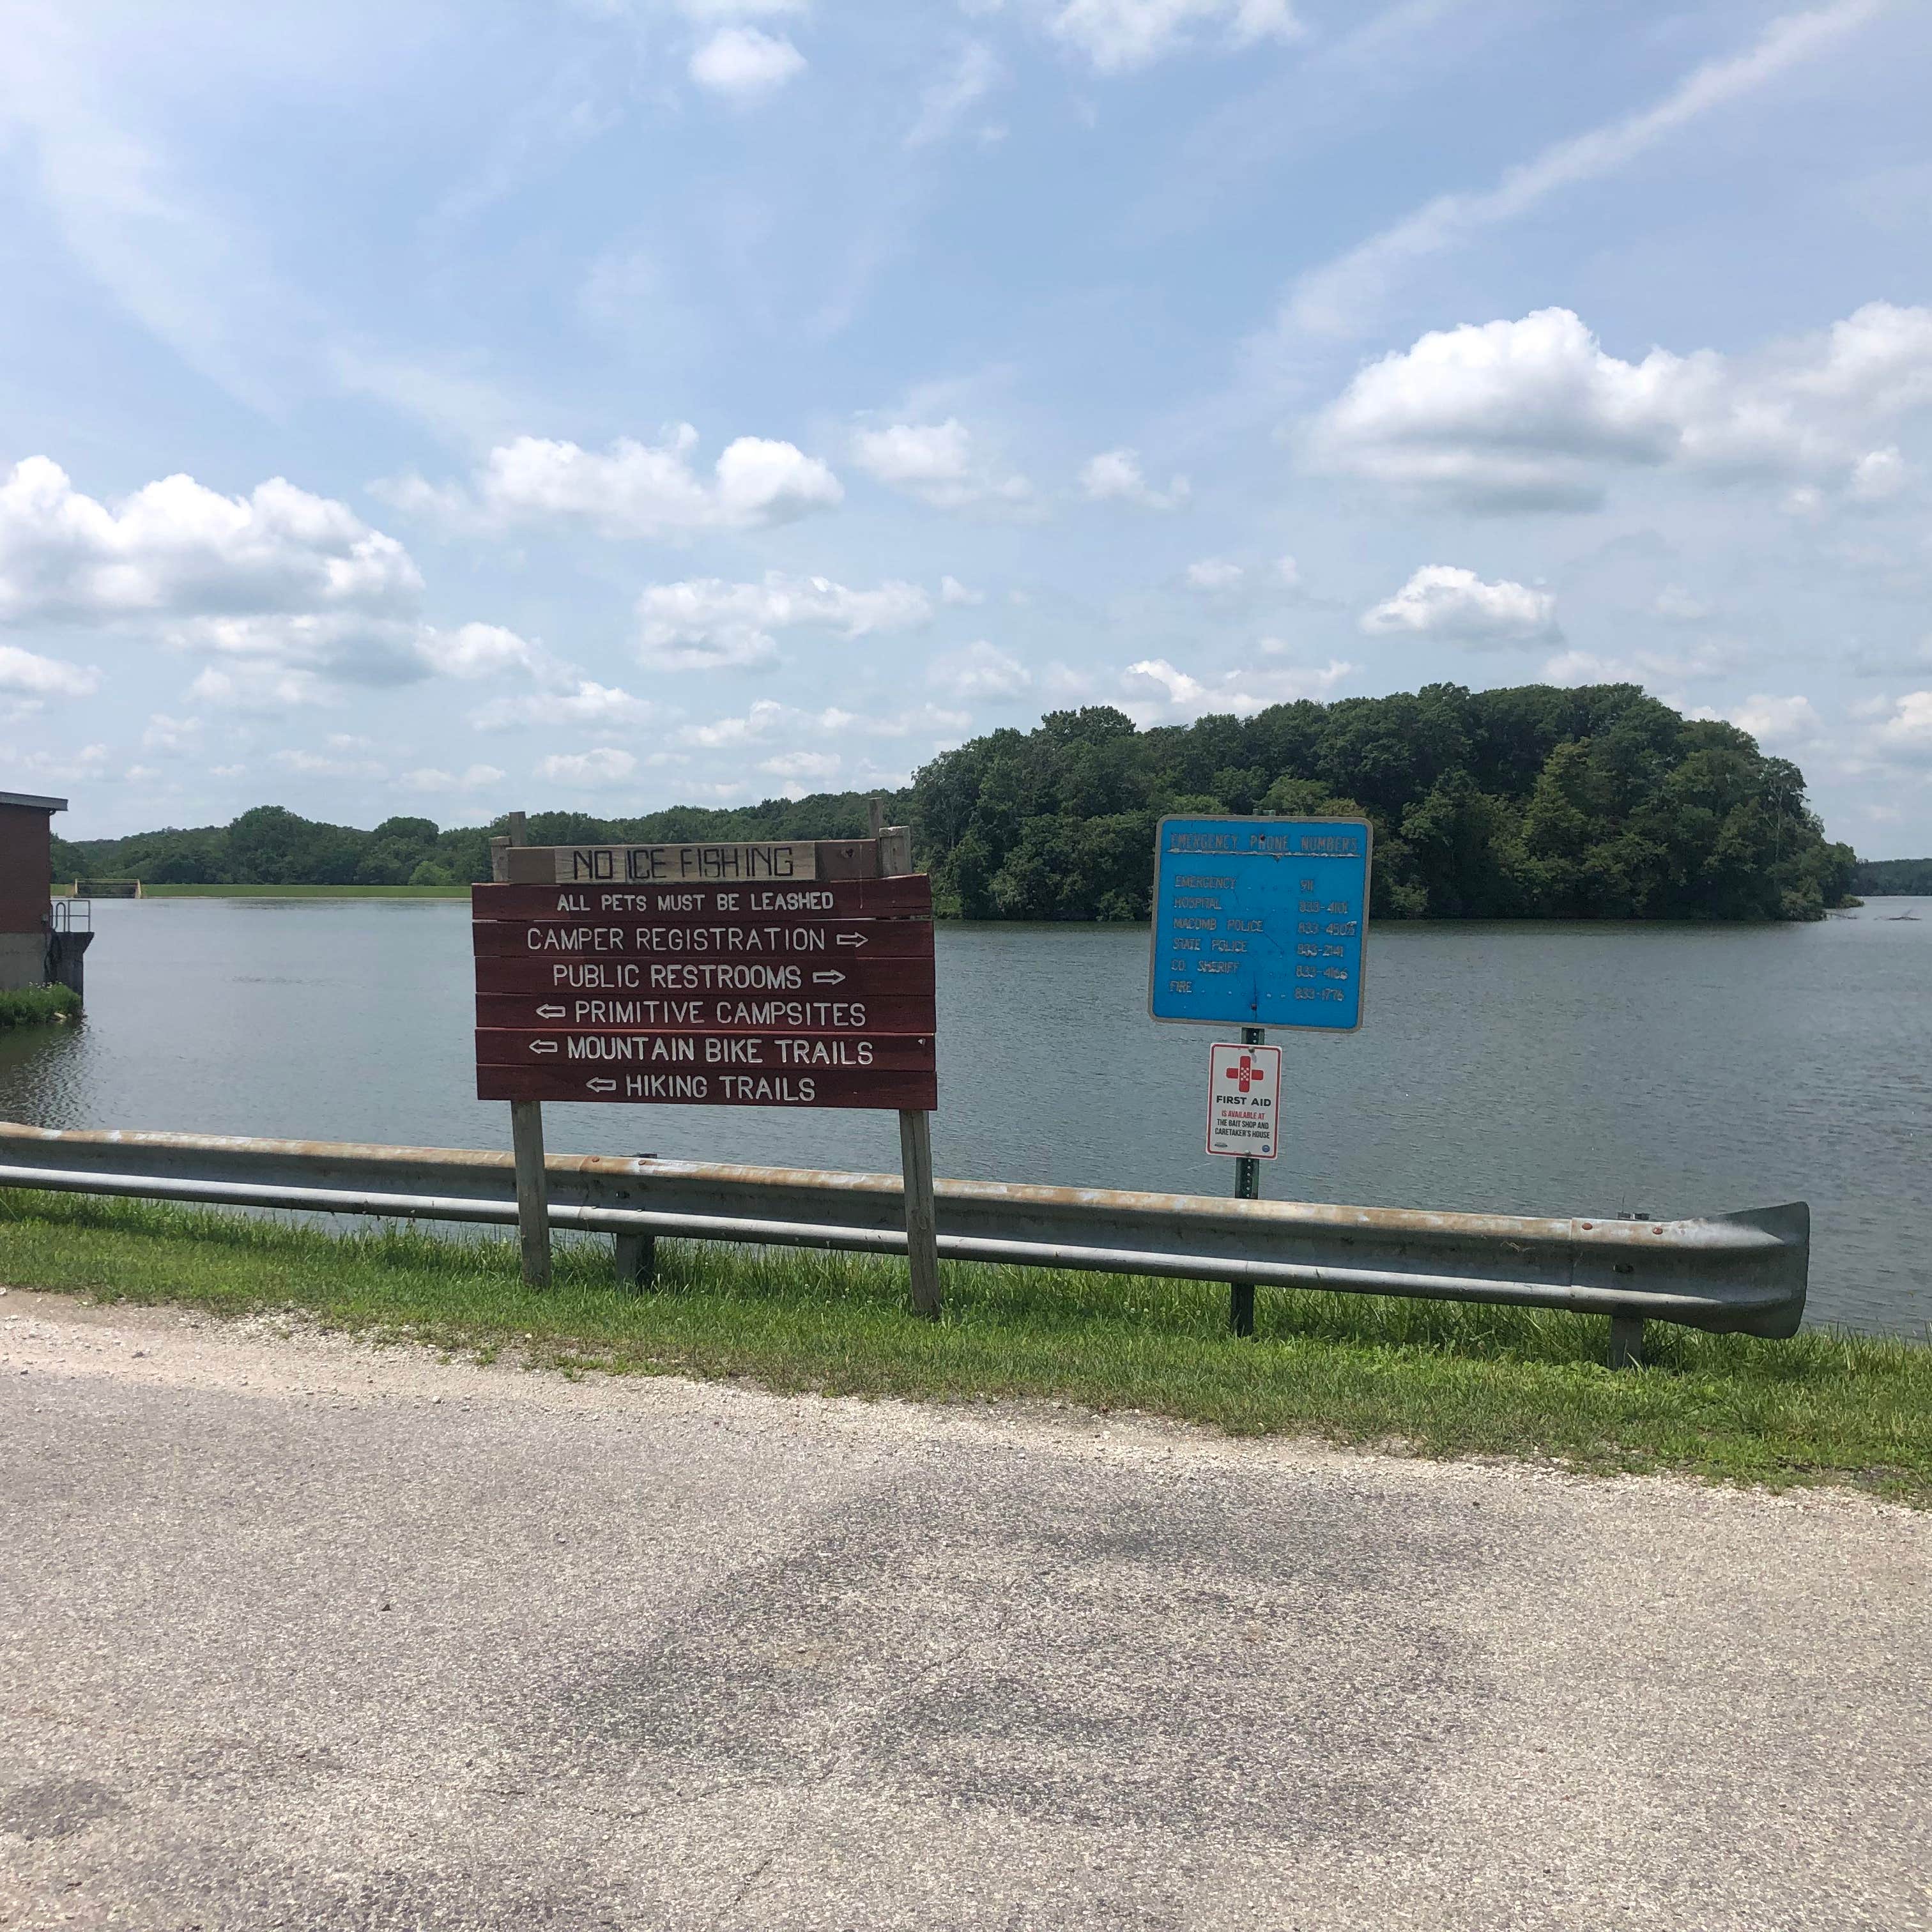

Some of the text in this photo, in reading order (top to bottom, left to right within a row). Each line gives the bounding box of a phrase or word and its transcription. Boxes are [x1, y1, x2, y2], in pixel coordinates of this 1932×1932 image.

[1170, 833, 1357, 851] EMERGENCY PHONE NUMBERS
[574, 847, 793, 880] NO ICE FISHING
[1175, 876, 1313, 891] EMERGENCY 911
[557, 891, 833, 911] ALL PETS MUST BE LEASHED
[1174, 898, 1222, 910] HOSPITAL
[1173, 918, 1216, 930] MACOMB
[1227, 919, 1264, 932] POLICE
[528, 927, 825, 951] CAMPER REGISTRATION
[1173, 939, 1200, 950] STATE
[1212, 940, 1247, 953] POLICE
[1197, 960, 1240, 974] SHERIFF
[554, 965, 801, 989] PUBLIC RESTROOMS
[1169, 981, 1192, 993] FIRE
[576, 1001, 866, 1026] PRIMITIVE CAMPSITES
[568, 1036, 873, 1064] MOUNTAIN BIKE TRAILS
[626, 1074, 815, 1101] HIKING TRAILS
[1216, 1096, 1247, 1105] FIRST
[1228, 1110, 1257, 1119] AVAILABLE
[1215, 1128, 1251, 1137] CARETAKER'S
